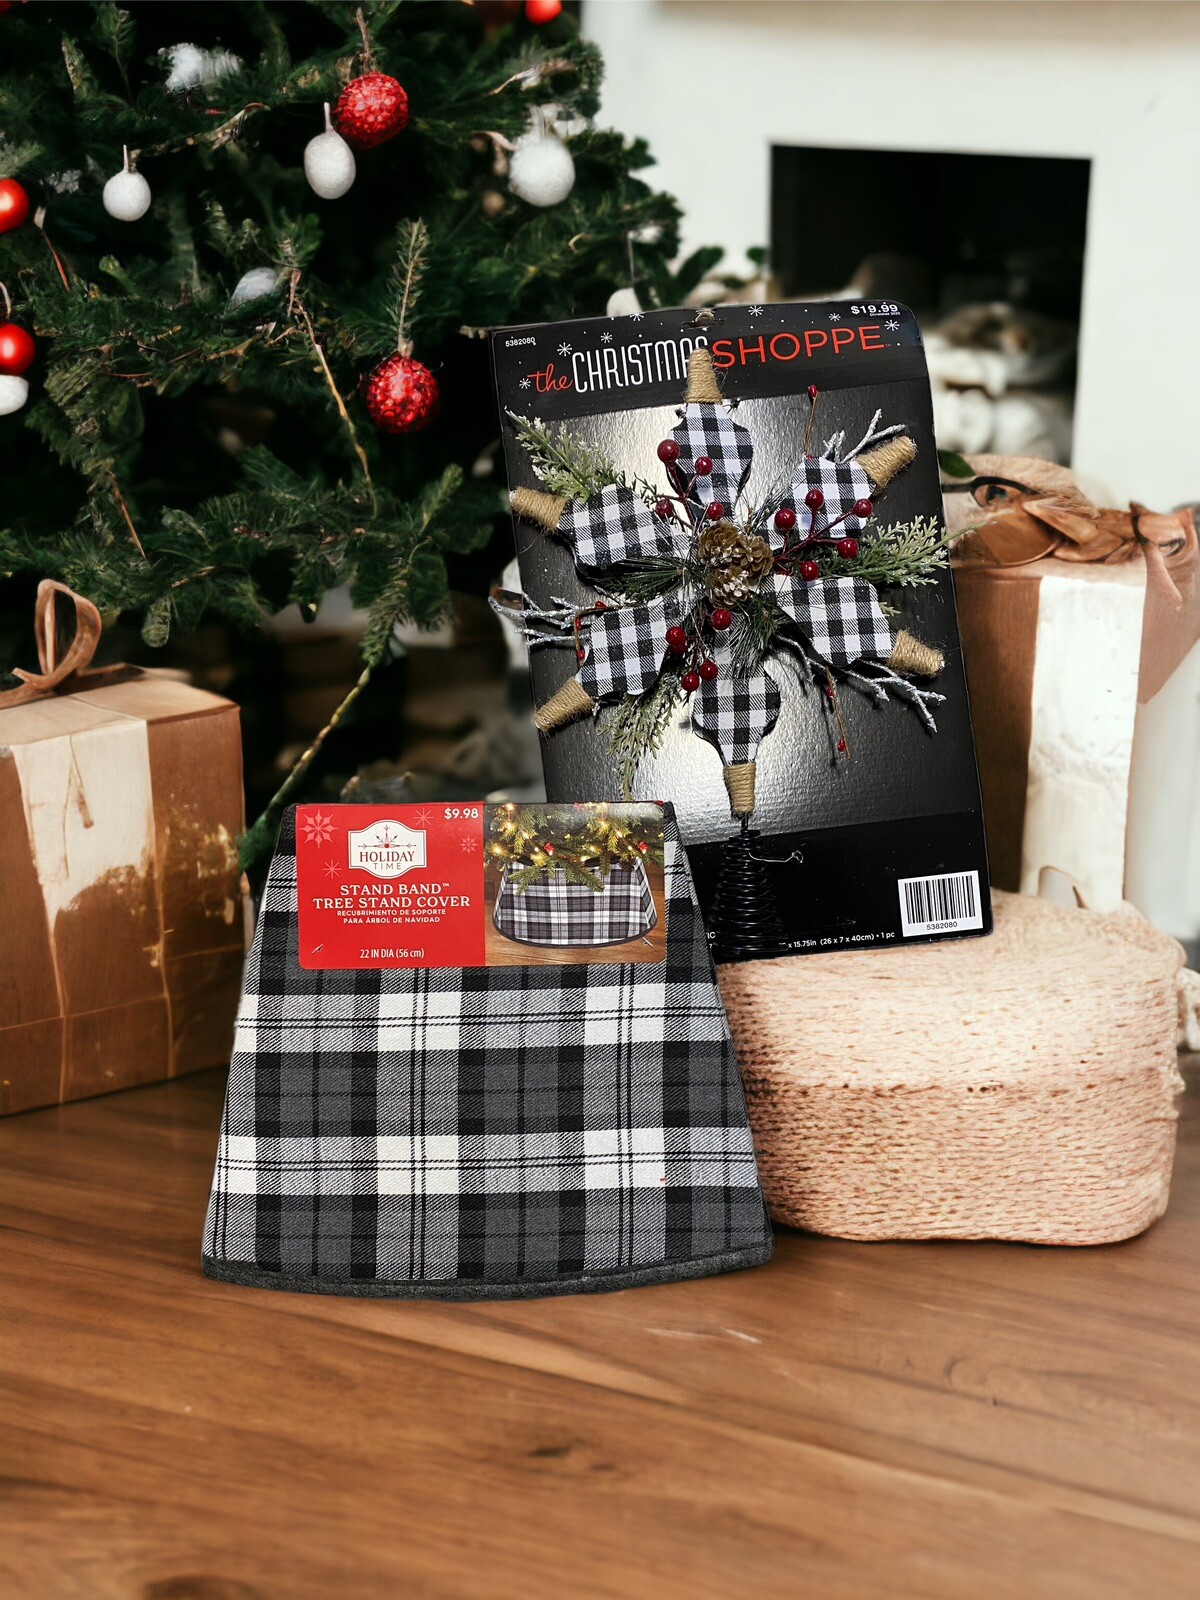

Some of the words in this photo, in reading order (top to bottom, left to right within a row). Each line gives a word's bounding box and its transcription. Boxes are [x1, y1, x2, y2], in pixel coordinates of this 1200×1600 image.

[850, 304, 898, 315] $19.99
[505, 336, 536, 347] 5382080
[526, 363, 573, 393] the
[444, 807, 479, 820] $9.98
[359, 851, 415, 863] HOLIDAY
[373, 862, 402, 870] TIME
[340, 884, 394, 896] STAND
[313, 898, 354, 909] TREE
[358, 897, 412, 909] STAND
[416, 896, 471, 907] COVER
[337, 909, 398, 917] RECUBRIMIENTO
[411, 908, 447, 916] SOPORTE
[343, 917, 364, 925] PARA
[365, 916, 391, 924] ÁRBOL
[404, 916, 441, 924] NAVIDAD
[926, 921, 958, 931] 5382080
[793, 939, 817, 948] 15.75in
[819, 937, 832, 946] (26
[851, 933, 875, 942] 40cm)
[885, 931, 896, 940] pc
[359, 949, 370, 959] 22
[370, 948, 380, 958] IN
[380, 948, 394, 958] DIA
[395, 948, 409, 959] (56
[409, 947, 425, 959] cm)
